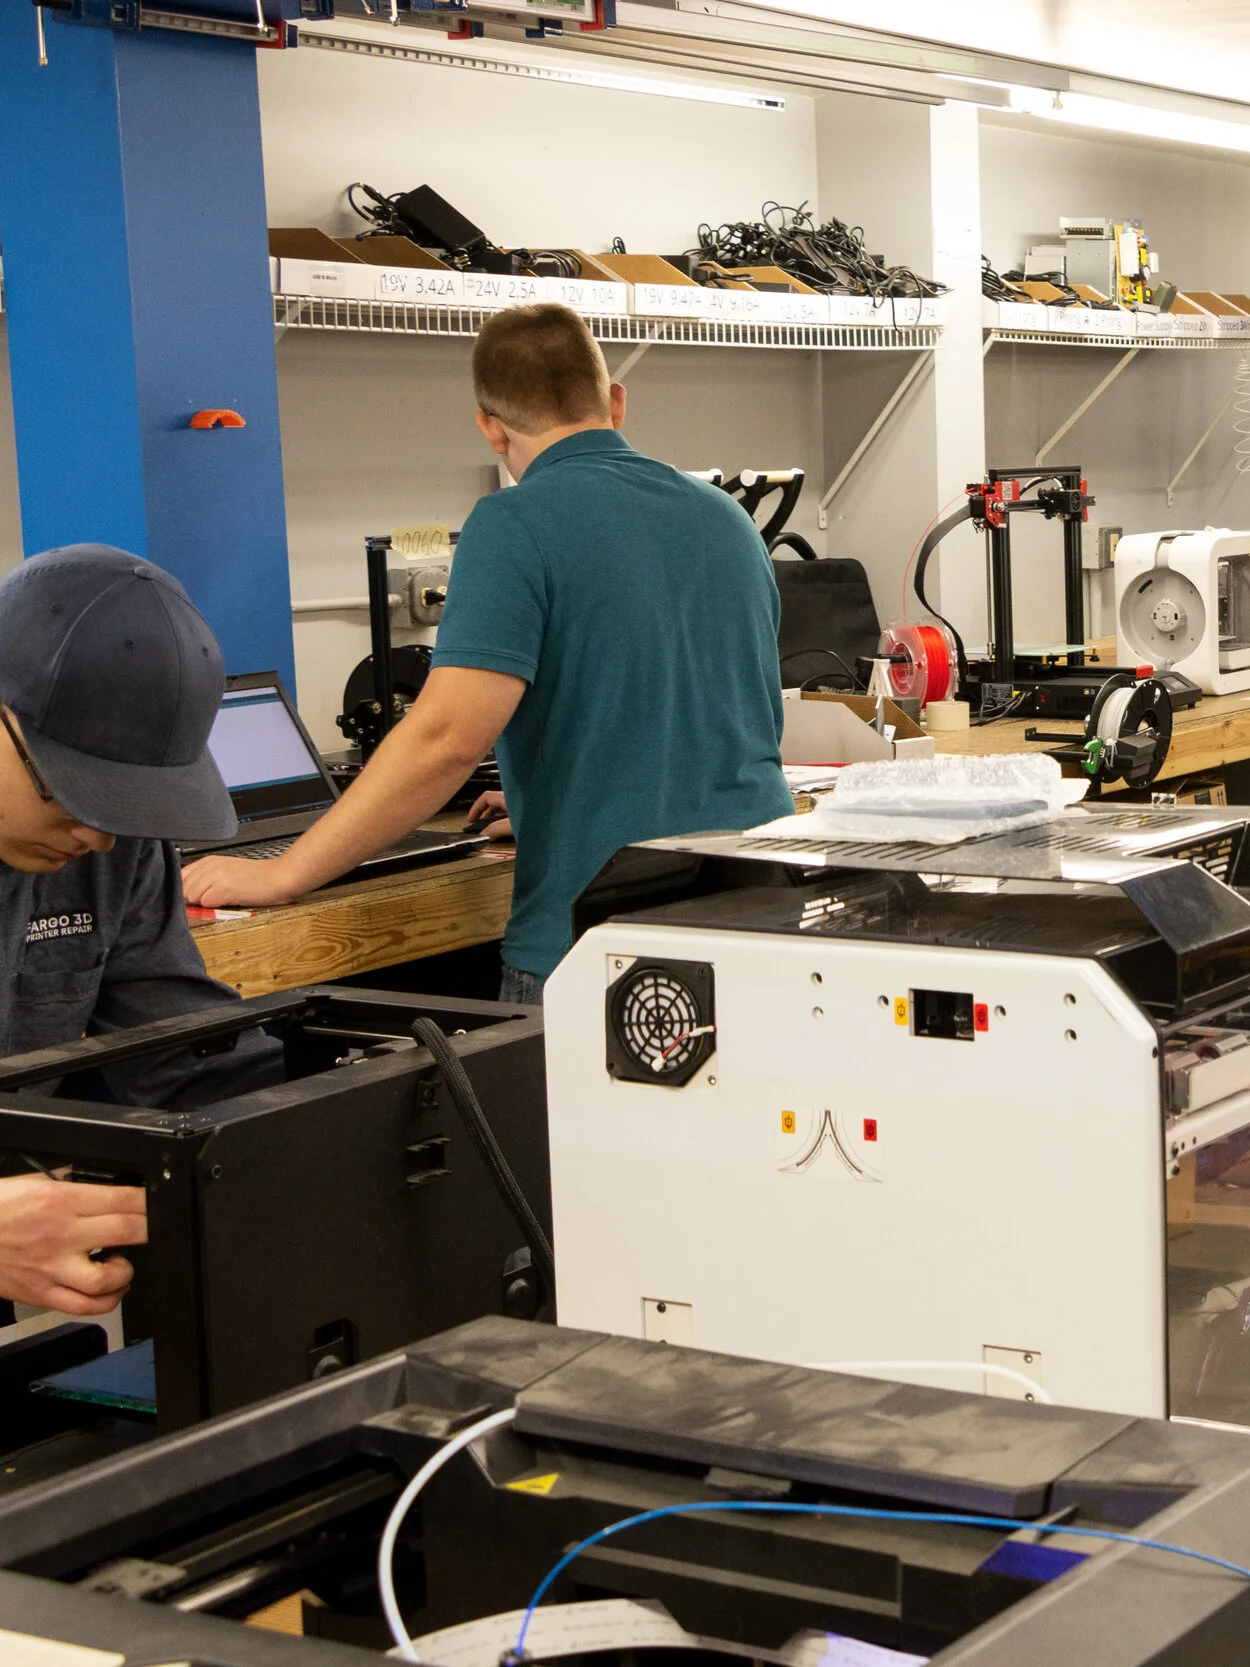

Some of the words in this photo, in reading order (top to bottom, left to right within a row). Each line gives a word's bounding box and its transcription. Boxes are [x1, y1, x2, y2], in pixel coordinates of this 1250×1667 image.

[381, 273, 407, 292] 19V
[415, 277, 455, 296] 3.42A
[476, 280, 500, 297] 24V
[508, 282, 536, 299] 2.5A
[561, 285, 584, 302] 12V
[592, 287, 615, 304] 10A
[643, 288, 663, 304] 19V
[671, 290, 701, 306] 9.47A
[73, 913, 93, 925] 3D
[26, 929, 59, 943] PRINTER
[61, 925, 93, 936] REPAIR
